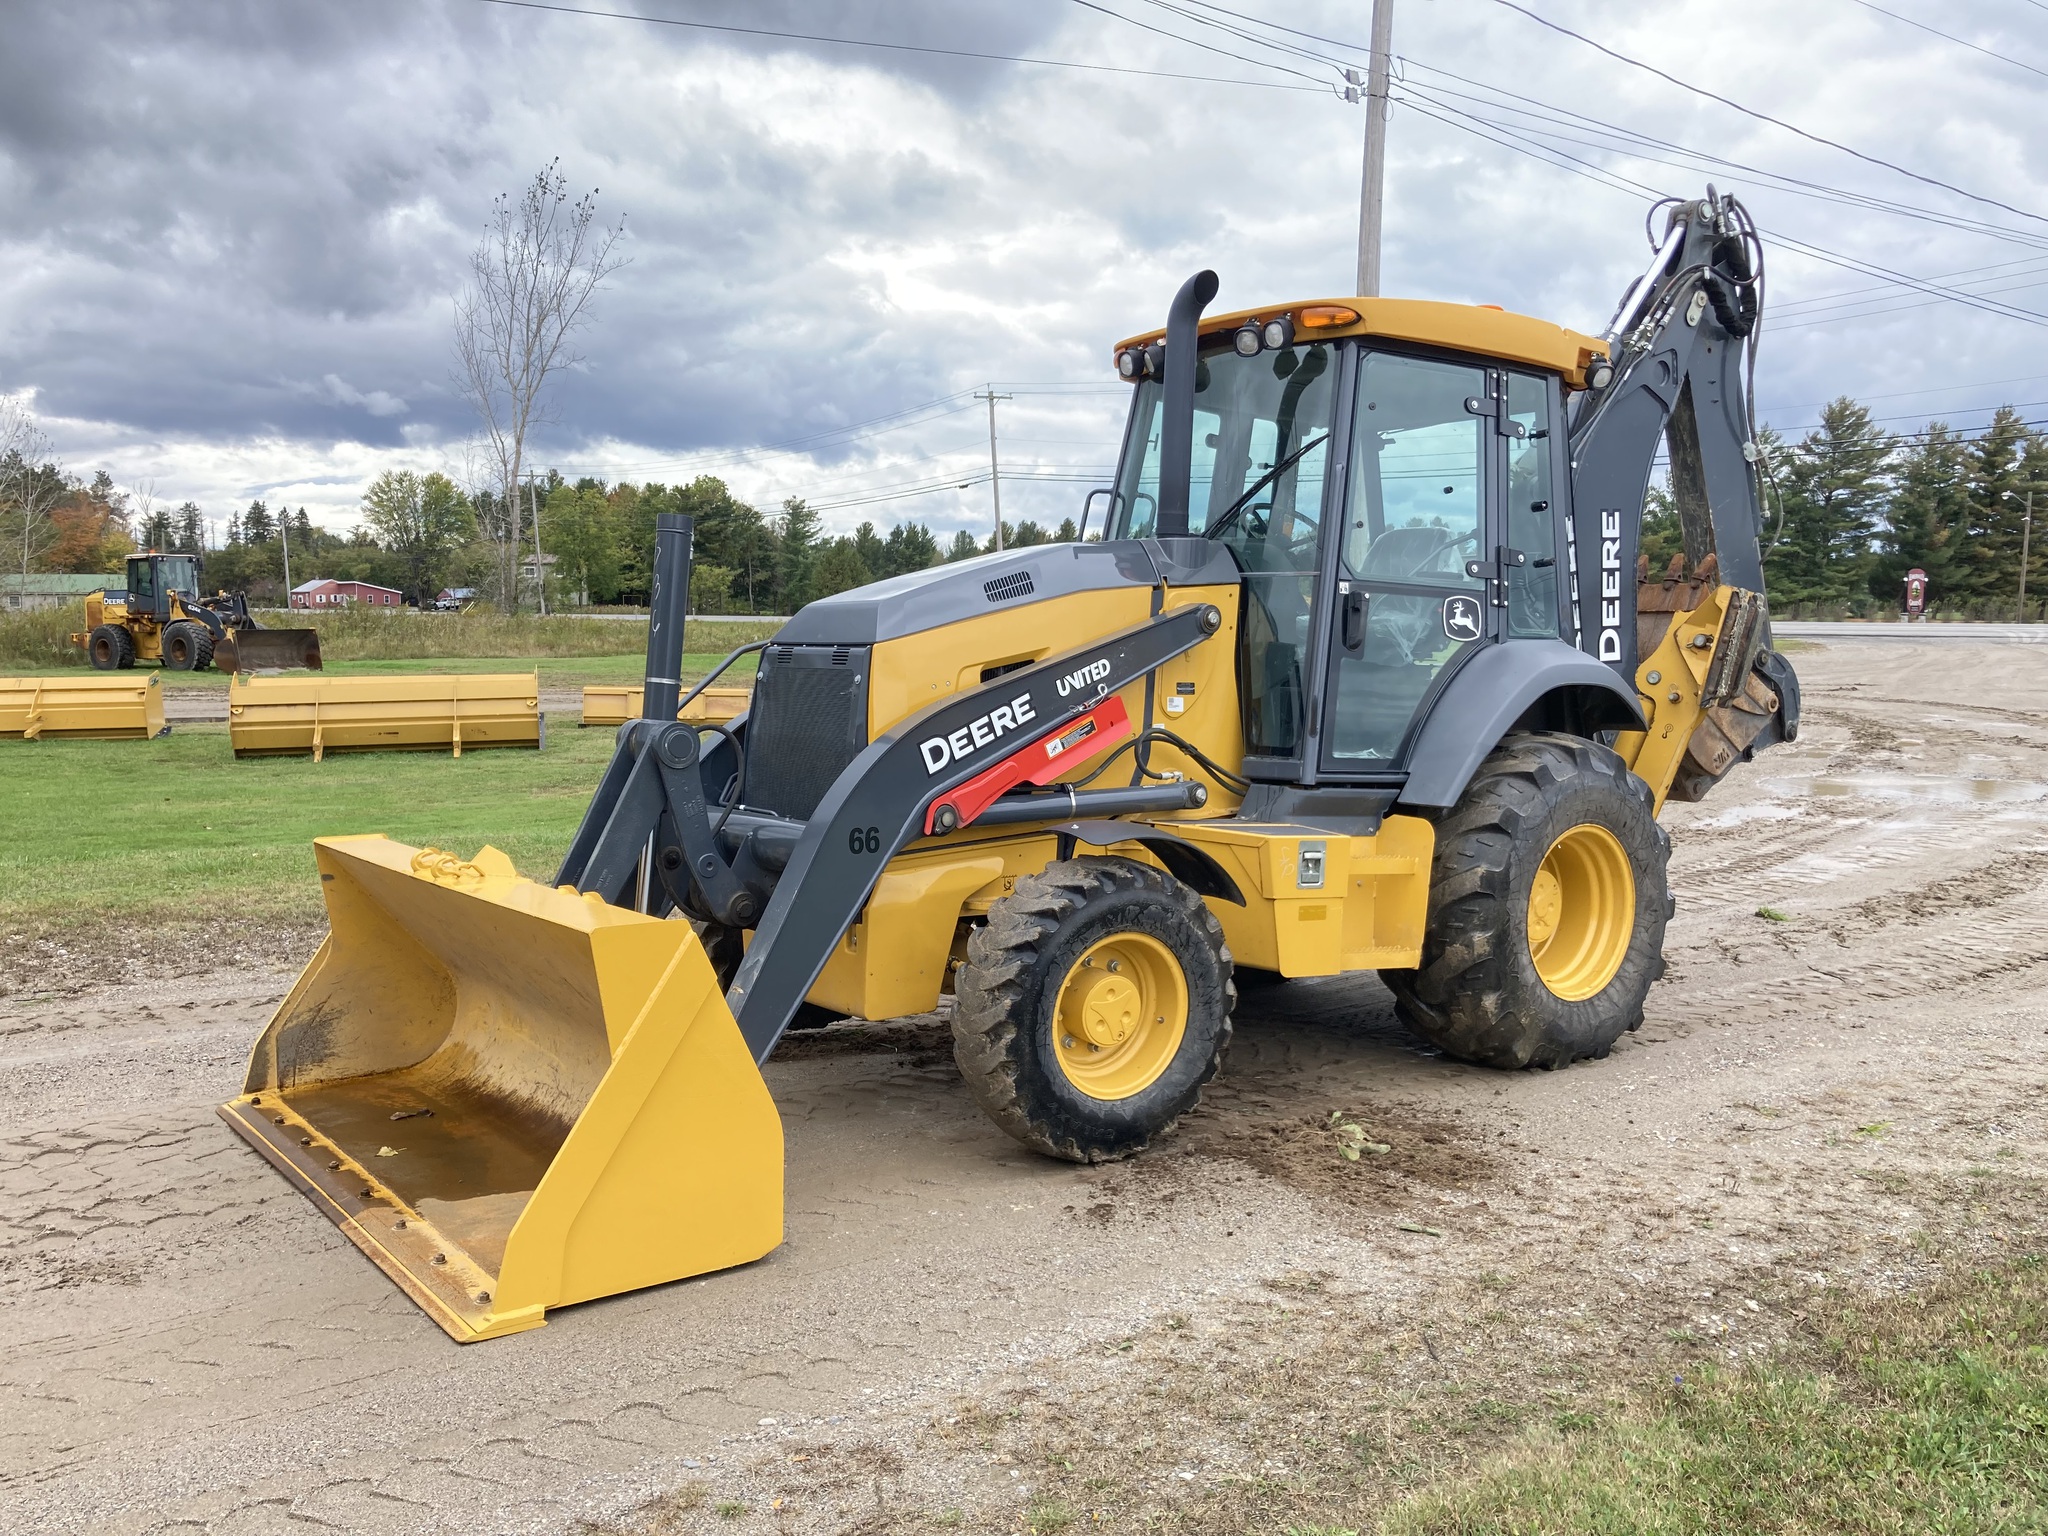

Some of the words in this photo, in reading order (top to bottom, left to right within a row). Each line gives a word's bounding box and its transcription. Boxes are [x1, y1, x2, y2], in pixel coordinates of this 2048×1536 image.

[1599, 511, 1621, 662] DEERE
[1055, 658, 1111, 697] UNITED
[919, 692, 1036, 775] DEERE
[848, 826, 880, 855] 66
